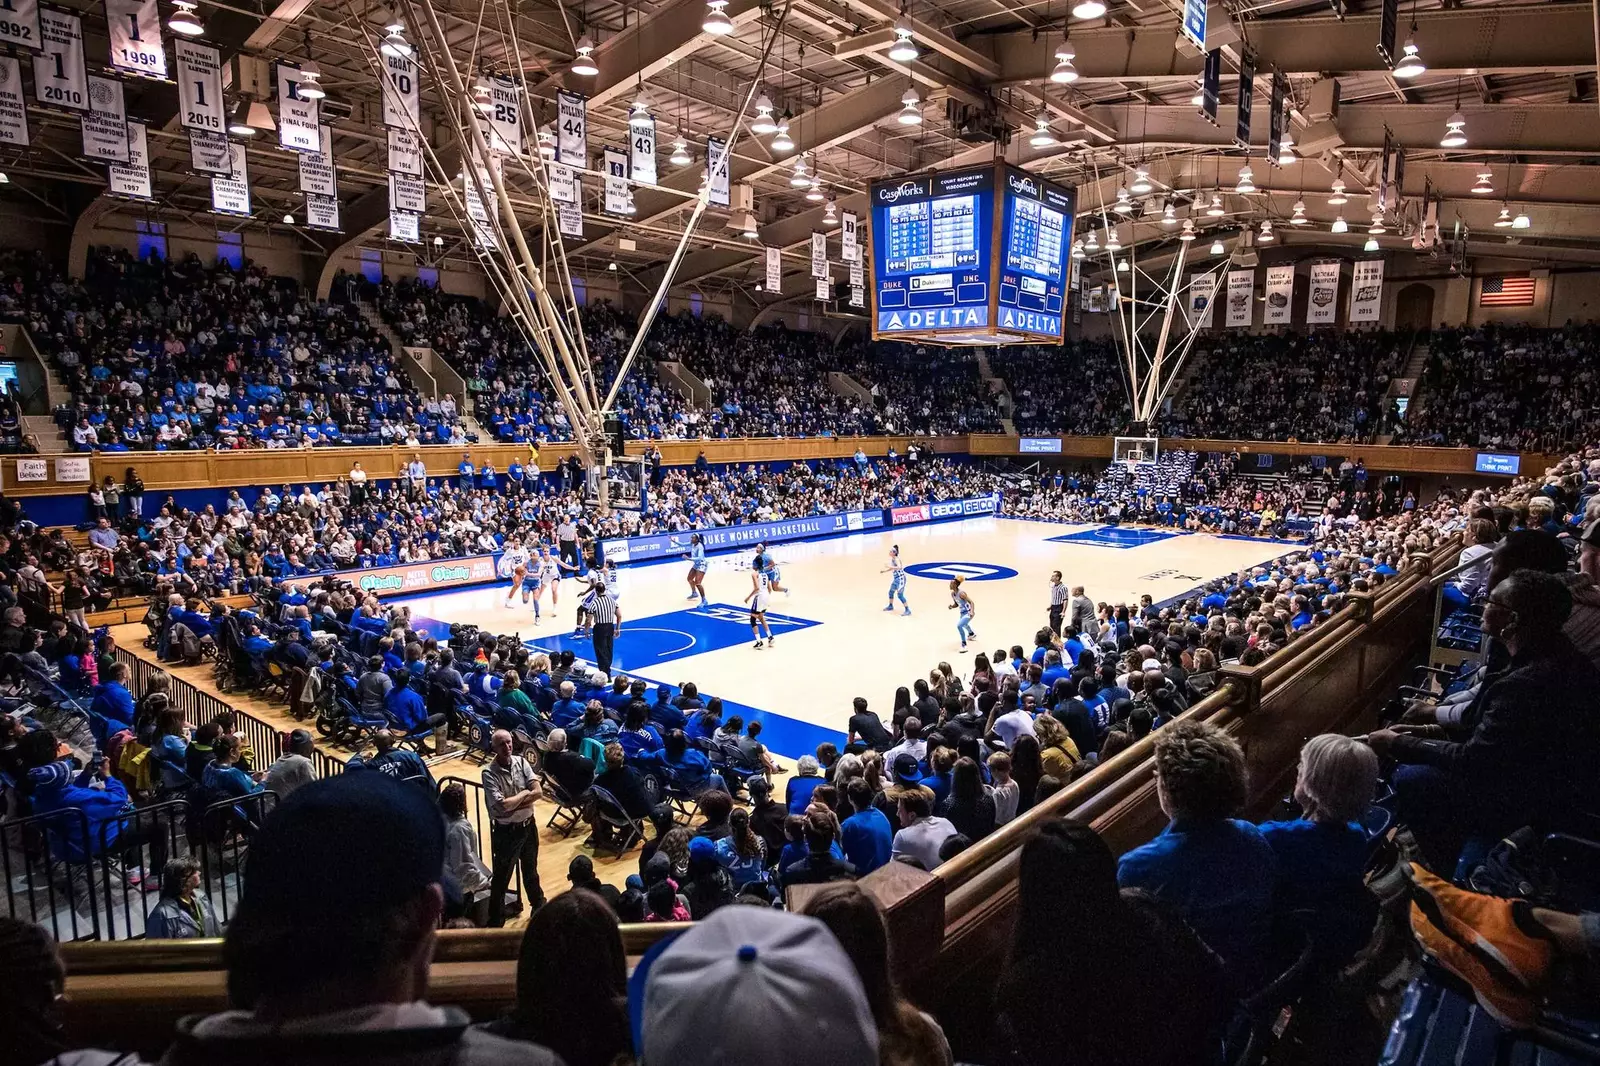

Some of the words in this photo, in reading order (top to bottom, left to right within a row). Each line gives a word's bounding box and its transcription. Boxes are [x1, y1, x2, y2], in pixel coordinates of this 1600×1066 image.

[126, 13, 144, 43] 1
[121, 49, 156, 66] 1999
[195, 52, 212, 61] TODAY
[51, 53, 69, 81] 1
[187, 65, 211, 76] RANKING
[194, 59, 220, 70] NATIONAL
[389, 56, 411, 73] GROAT
[390, 73, 411, 95] 10
[44, 86, 81, 105] 2010
[193, 81, 209, 107] 1
[90, 109, 121, 121] OUTHERN
[291, 108, 309, 118] NCAA
[495, 103, 517, 125] 25
[188, 111, 219, 129] 2015
[282, 117, 300, 127] FINAL
[301, 121, 318, 131] FOUR
[85, 124, 124, 138] CHAMPIONS
[562, 119, 582, 138] 44
[192, 140, 227, 151] CHAMPIONS
[397, 137, 411, 145] NCAA
[635, 137, 651, 155] 43
[98, 147, 116, 157] 1944
[389, 145, 405, 154] FINAL
[300, 161, 332, 172] CONFERENCE
[555, 168, 568, 176] NCAA
[111, 167, 147, 179] CHAMPIONS
[302, 168, 331, 179] CHAMPIONS
[957, 174, 983, 183] REPORTING
[123, 184, 140, 192] 1997
[214, 179, 247, 190] CONFERENCE
[215, 186, 247, 196] CHAMPIONS
[880, 182, 924, 203] CaseWorks
[883, 281, 903, 289] DUKE
[963, 275, 980, 283] UNC
[1194, 278, 1212, 286] NATIONAL
[1190, 284, 1214, 292] CHAMPIONS
[1228, 282, 1252, 290] CHAMPIONS
[909, 310, 979, 327] DELTA
[1018, 311, 1057, 333] DELTA
[932, 503, 963, 517] GEICO
[964, 499, 995, 514] GEICO
[892, 512, 921, 524] Ameritas
[702, 533, 726, 545] DUKE
[729, 526, 769, 542] WOMEN'S
[771, 521, 821, 537] BASKETBALL
[432, 566, 470, 582] O'Reilly
[473, 561, 491, 571] AUTO
[471, 568, 494, 580] PARTS
[360, 574, 404, 591] O'Reilly
[407, 569, 426, 579] AUTO
[405, 576, 430, 587] PARTS
